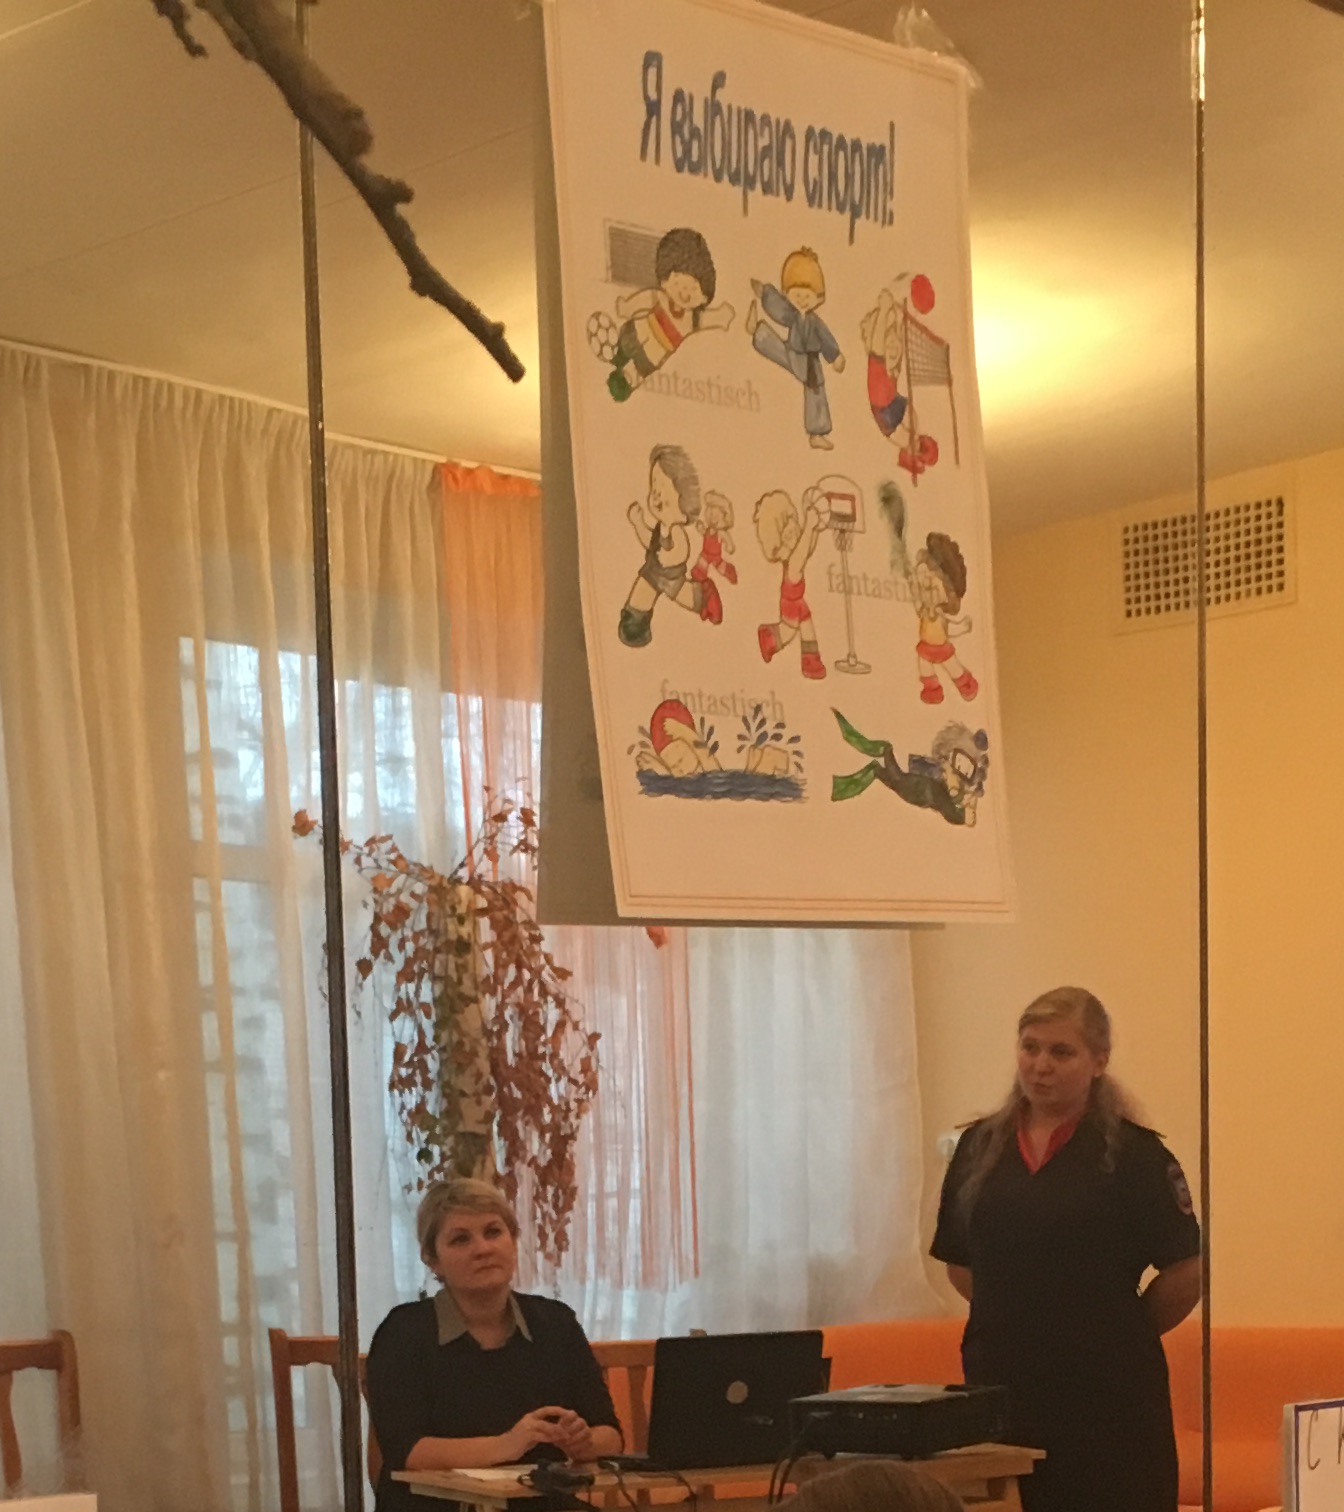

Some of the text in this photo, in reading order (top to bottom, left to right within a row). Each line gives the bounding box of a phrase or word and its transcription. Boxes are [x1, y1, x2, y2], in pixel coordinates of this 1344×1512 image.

[640, 50, 896, 246] Я выбираю спорт!
